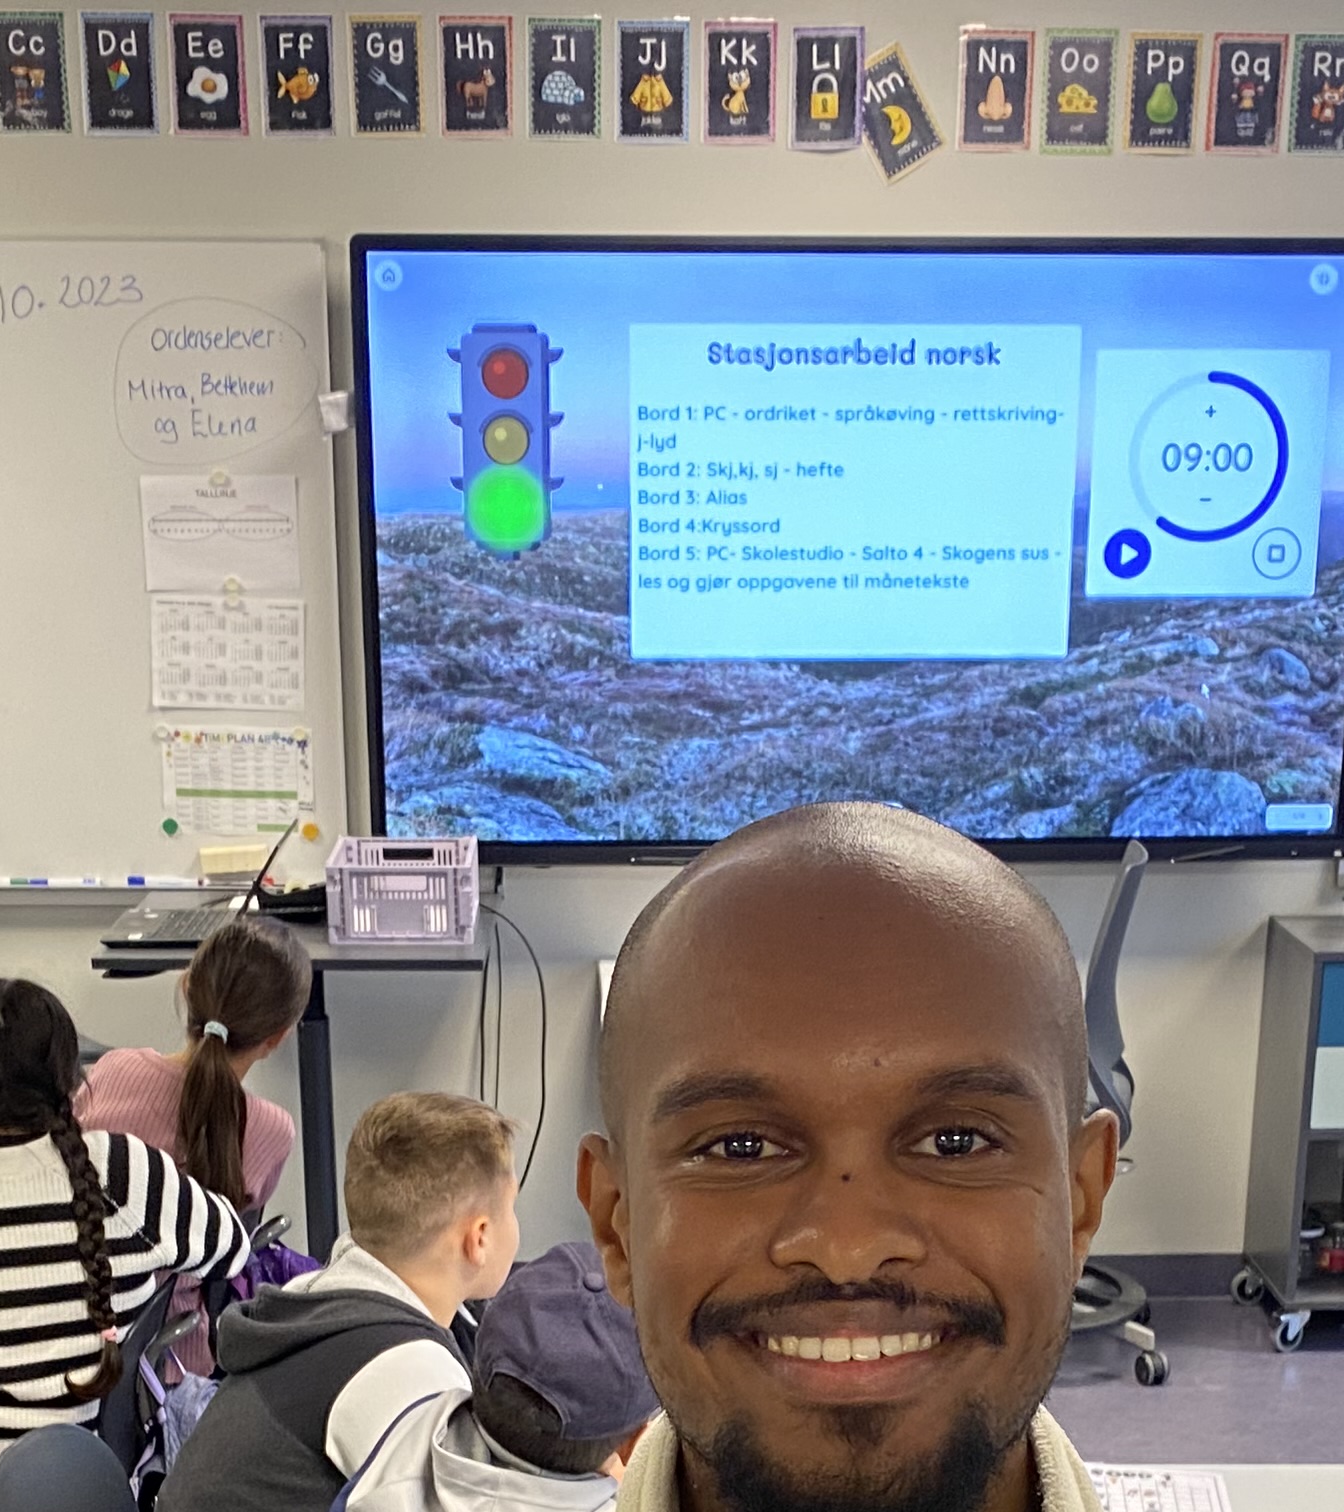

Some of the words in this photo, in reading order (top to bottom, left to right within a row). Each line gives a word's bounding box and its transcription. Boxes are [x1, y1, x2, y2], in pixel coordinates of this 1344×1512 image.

[8, 29, 45, 55] Cc
[97, 30, 138, 57] Dd
[186, 31, 225, 58] Ee
[279, 32, 313, 59] Ff
[365, 33, 405, 64] Gg
[456, 33, 494, 60] Hh
[638, 38, 667, 71] Jj
[720, 38, 758, 66] Kk
[812, 43, 840, 70] Ll
[978, 47, 1016, 74] Nn
[1061, 48, 1100, 74] Oo
[1146, 50, 1185, 81] Pp
[1230, 49, 1271, 81] Qq
[707, 337, 917, 371] Stasjonsarbeid
[926, 340, 1002, 366] norsk
[154, 417, 179, 445] og
[191, 407, 258, 439] Elena
[637, 405, 682, 422] Bord
[685, 406, 699, 422] 1:
[703, 406, 727, 422] PC
[744, 405, 817, 422] ordriket
[834, 404, 936, 425] språkøving
[953, 405, 1065, 425] rettskriving-
[636, 433, 677, 453] j-lyd
[1161, 441, 1254, 473] 09:00
[637, 462, 682, 478] Bord
[686, 462, 702, 478] 2:
[763, 463, 779, 482] sj
[796, 461, 845, 478] hefte
[637, 490, 682, 506] Bord
[686, 490, 701, 506] 3:
[705, 490, 748, 506] Alias
[638, 518, 682, 534] Bord
[638, 546, 682, 562] Bord
[686, 546, 701, 562] 5:
[741, 545, 845, 562] Skolestudio
[861, 545, 903, 562] Salto
[907, 546, 924, 562] 4
[941, 545, 1016, 565] Skogens
[1020, 549, 1050, 563] sus
[637, 573, 662, 590] les
[667, 576, 691, 594] og
[695, 574, 733, 594] gjør
[736, 576, 838, 594] oppgavene
[842, 573, 860, 589] til
[864, 572, 970, 590] månetekste
